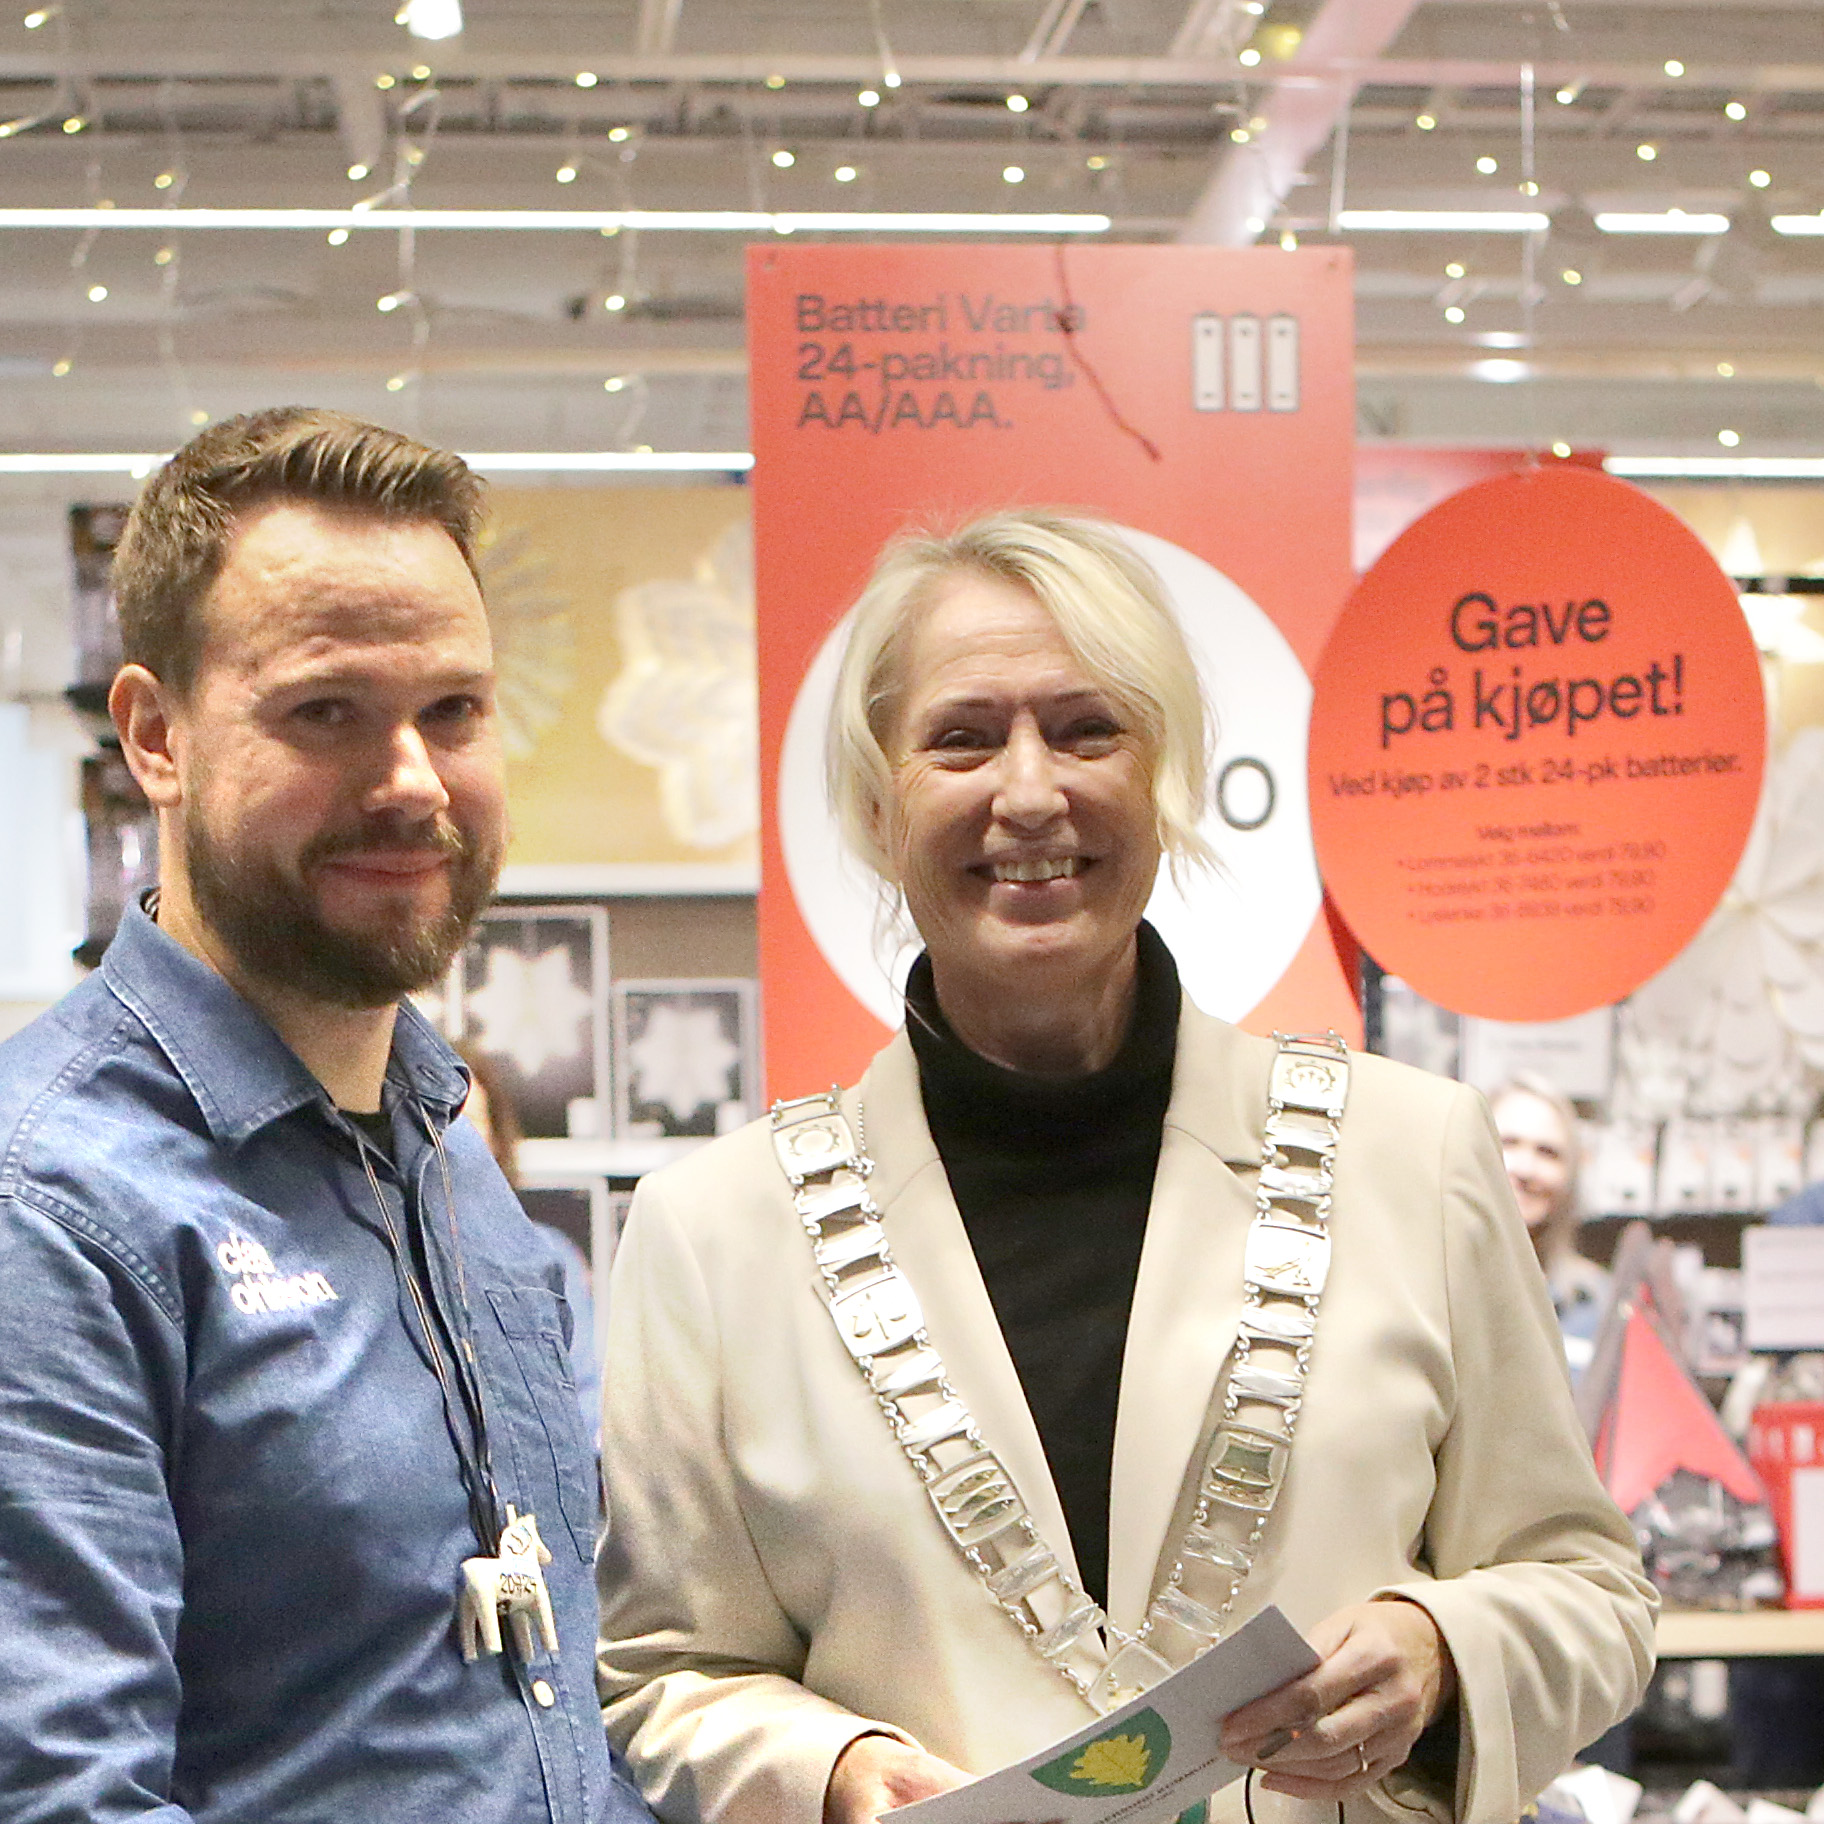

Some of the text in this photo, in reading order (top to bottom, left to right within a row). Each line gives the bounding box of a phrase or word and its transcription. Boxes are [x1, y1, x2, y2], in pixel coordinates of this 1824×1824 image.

[796, 294, 1086, 332] Batteri Varta
[798, 392, 1013, 433] AA/AAA.
[1450, 592, 1612, 653] Gave
[1380, 654, 1684, 749] på kjøpet!
[1329, 771, 1375, 796] Ved
[1381, 769, 1433, 798] kjøp
[1441, 771, 1466, 791] av
[1475, 763, 1490, 788] 2
[1497, 762, 1532, 787] stk
[1542, 755, 1618, 787] 24-pk
